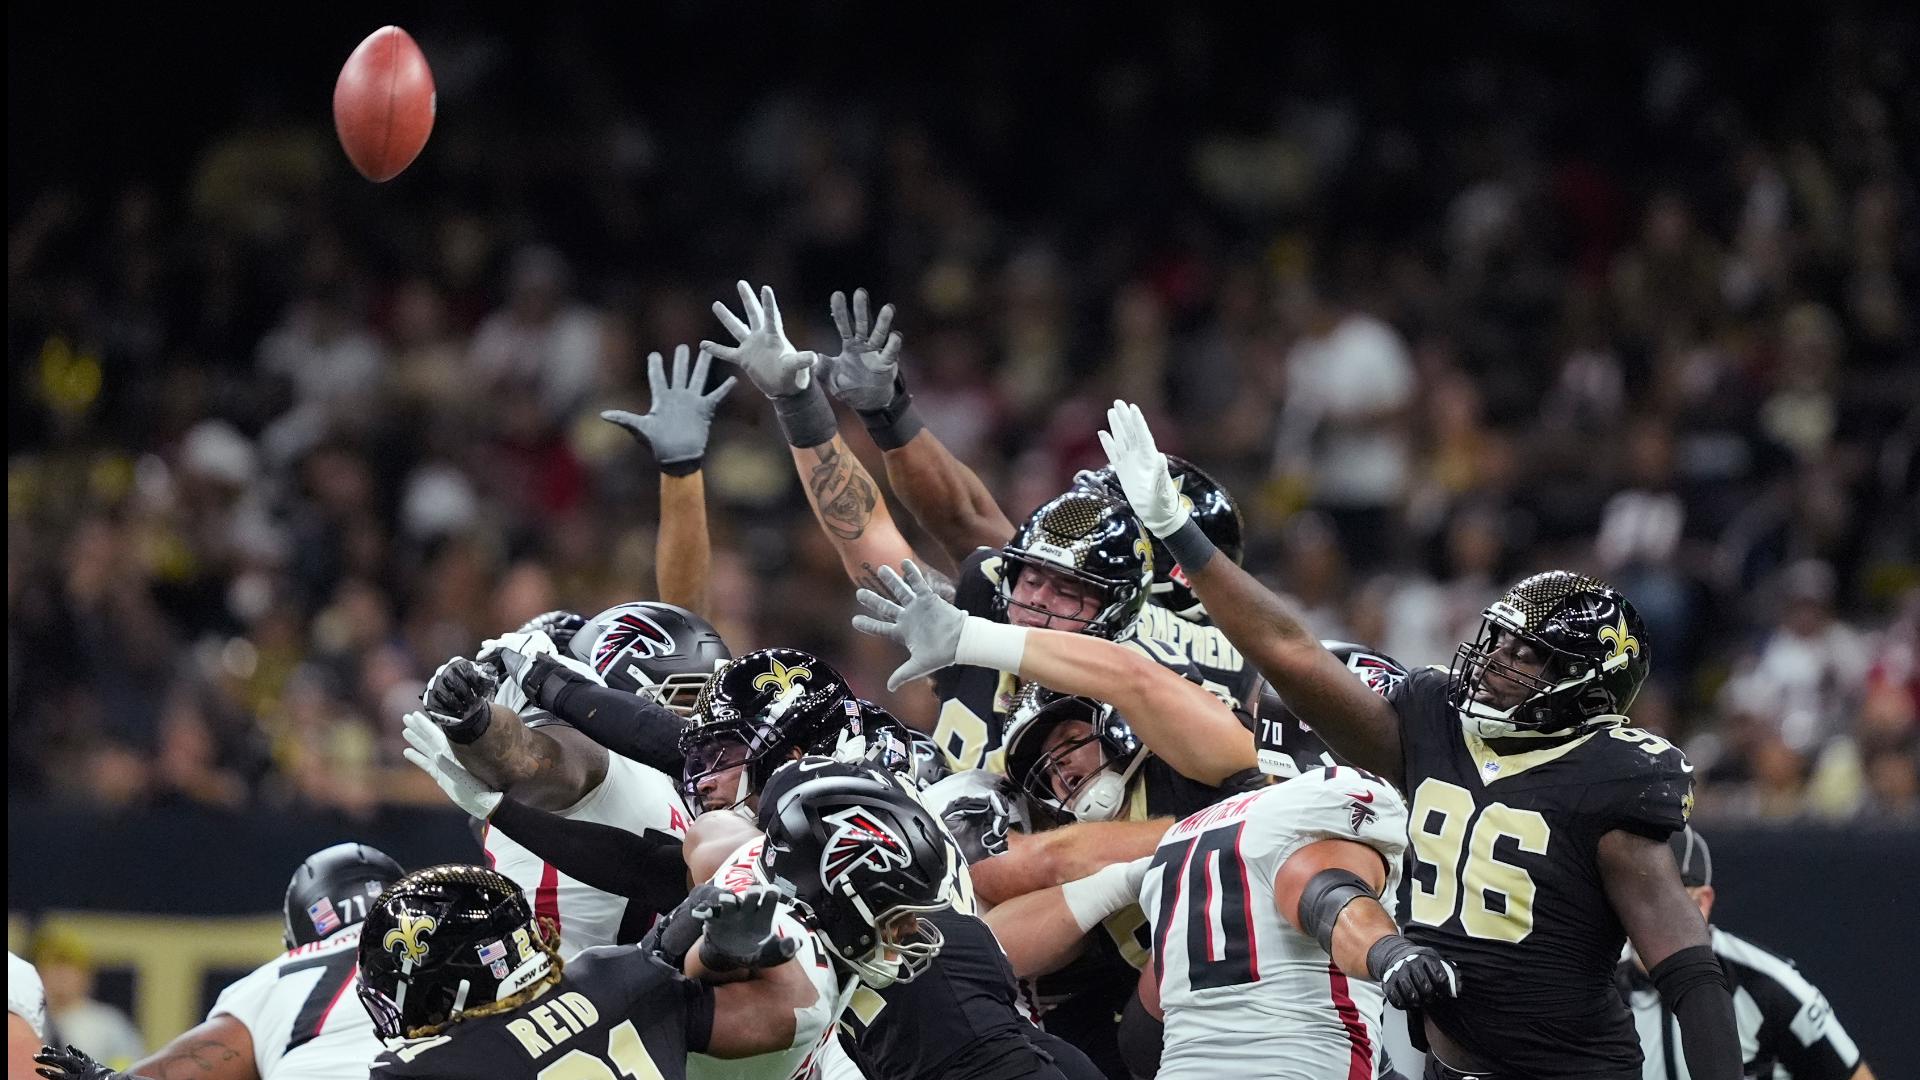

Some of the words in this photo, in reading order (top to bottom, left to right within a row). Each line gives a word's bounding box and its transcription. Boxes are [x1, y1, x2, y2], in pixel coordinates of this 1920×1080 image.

[1262, 718, 1283, 746] 70
[1608, 727, 1672, 755] 9
[1258, 757, 1292, 769] ALCONS
[1408, 776, 1551, 944] 96
[337, 894, 367, 924] 71
[1148, 820, 1261, 1000] 70
[514, 967, 537, 989] NEW
[505, 991, 600, 1060] REID
